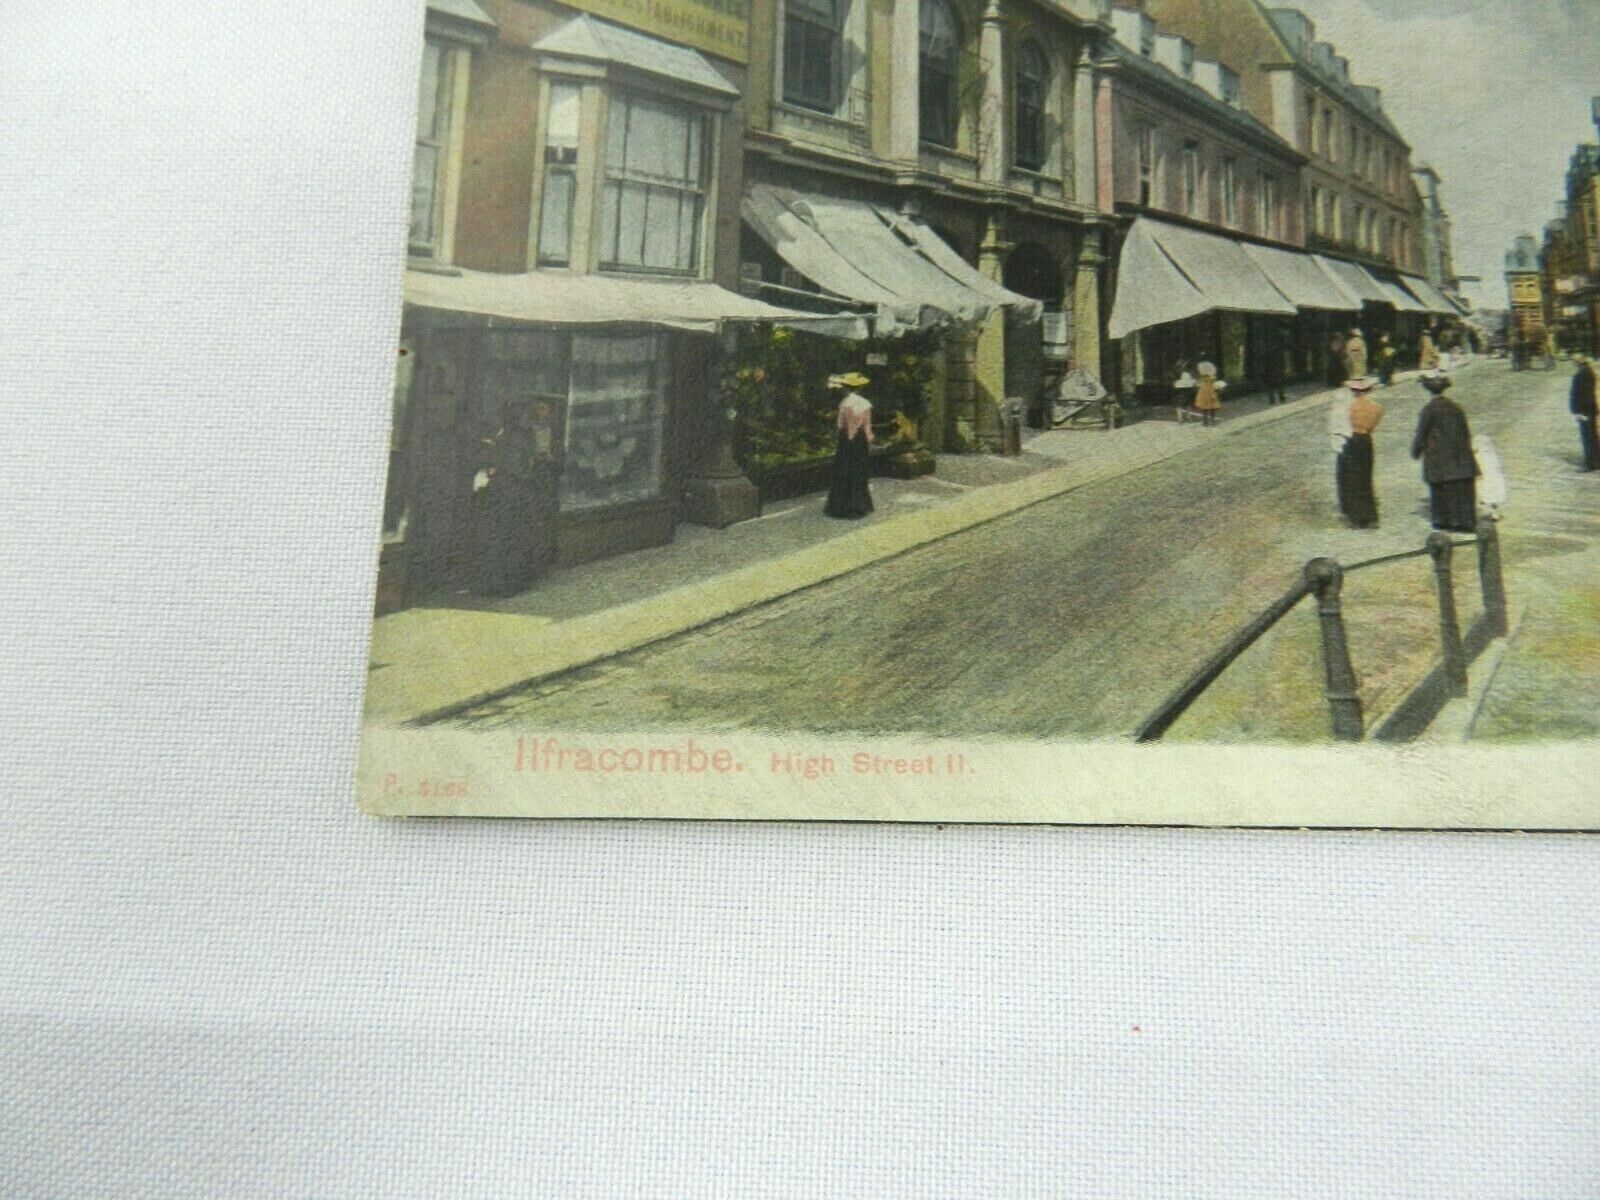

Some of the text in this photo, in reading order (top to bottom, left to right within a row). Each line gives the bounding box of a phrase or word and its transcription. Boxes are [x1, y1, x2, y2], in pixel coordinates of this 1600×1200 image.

[514, 737, 744, 773] Ilfracombe.
[770, 751, 835, 780] High
[852, 752, 934, 774] Street
